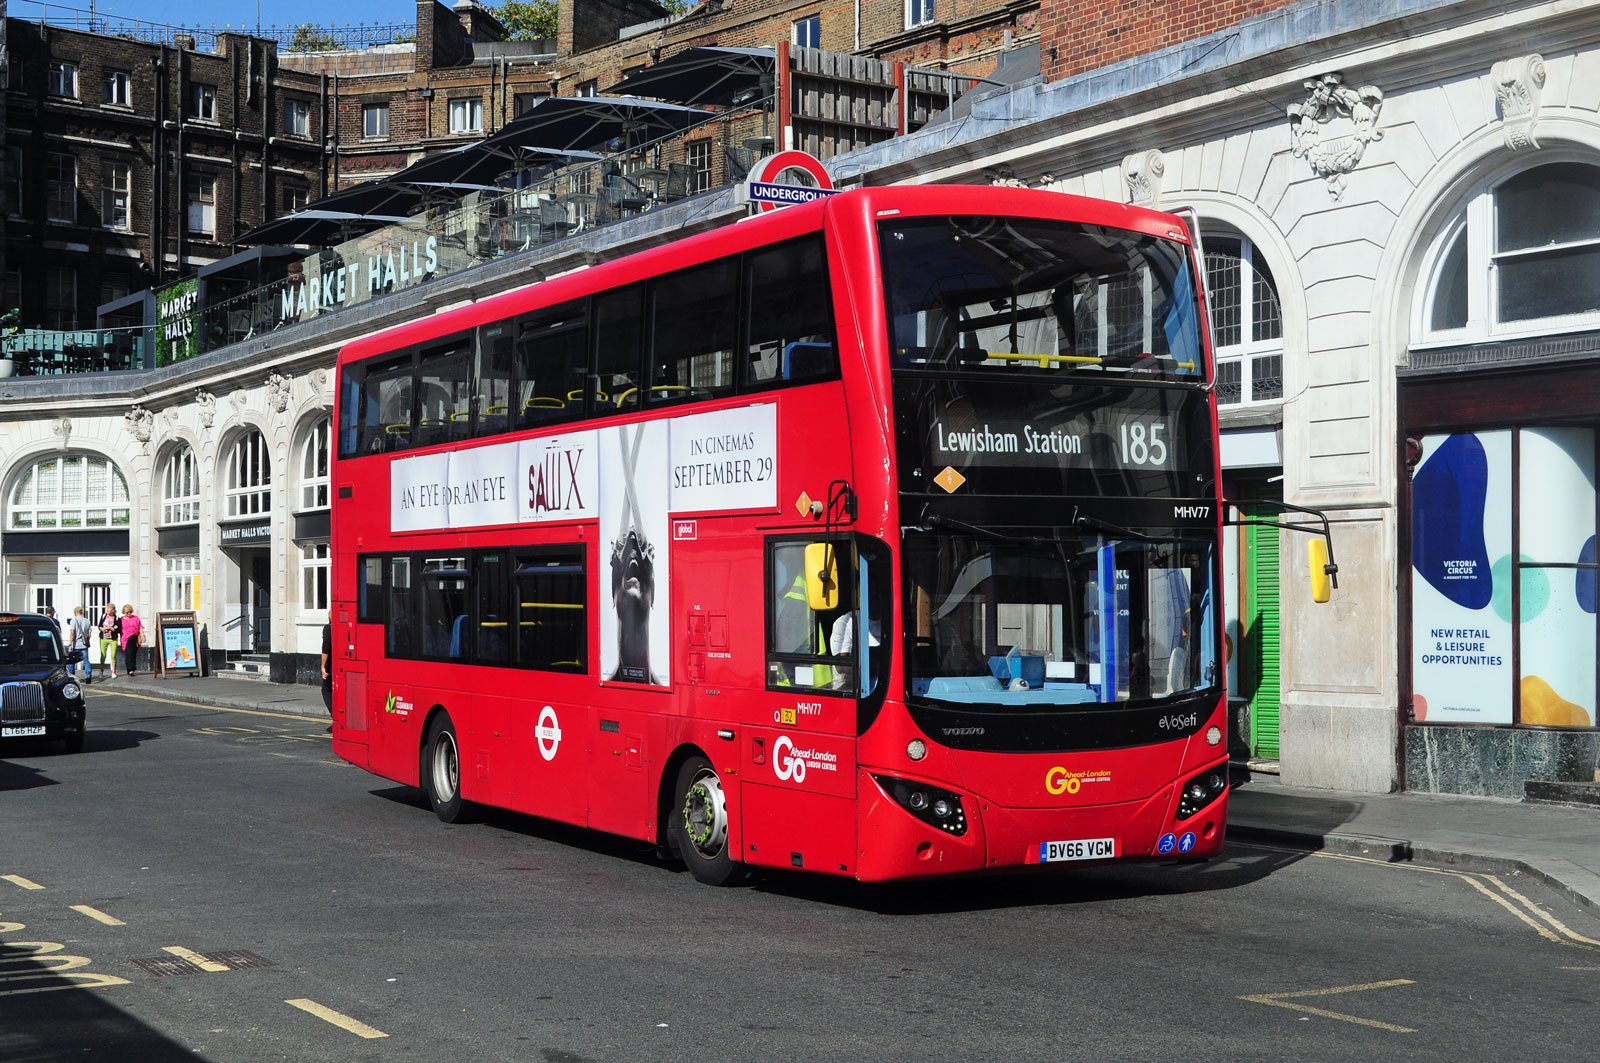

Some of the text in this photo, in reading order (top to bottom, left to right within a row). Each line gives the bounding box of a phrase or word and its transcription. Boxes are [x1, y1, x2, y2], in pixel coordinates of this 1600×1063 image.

[754, 186, 830, 202] UNDERGROU
[282, 236, 438, 320] MARKET HALLS
[161, 291, 198, 319] MARKET
[165, 318, 193, 341] HALLS
[691, 432, 754, 456] IN CINEMAS
[938, 421, 1167, 465] Lewisham Station 185
[529, 448, 586, 513] SAW X
[674, 457, 773, 488] SEPTEMBER 29
[401, 476, 506, 509] AN EYE FOR AN EYE
[1174, 506, 1210, 518] MHV77
[222, 526, 272, 539] MARKET HALLS VICTO
[678, 523, 693, 537] global
[1431, 629, 1490, 638] NEW RETAIL
[1436, 641, 1485, 652] & LEISURE
[1422, 654, 1502, 665] OPPORTUNITIES
[774, 710, 780, 722] Q
[797, 702, 821, 716] MHV77
[27, 726, 42, 734] HZP
[941, 727, 986, 736] VOLVO
[773, 735, 837, 783] Go Ahead-London
[806, 760, 837, 771] LONDON CENTRAL
[1045, 766, 1111, 795] Go Ahead-London
[1049, 840, 1112, 858] BV66 VGM
